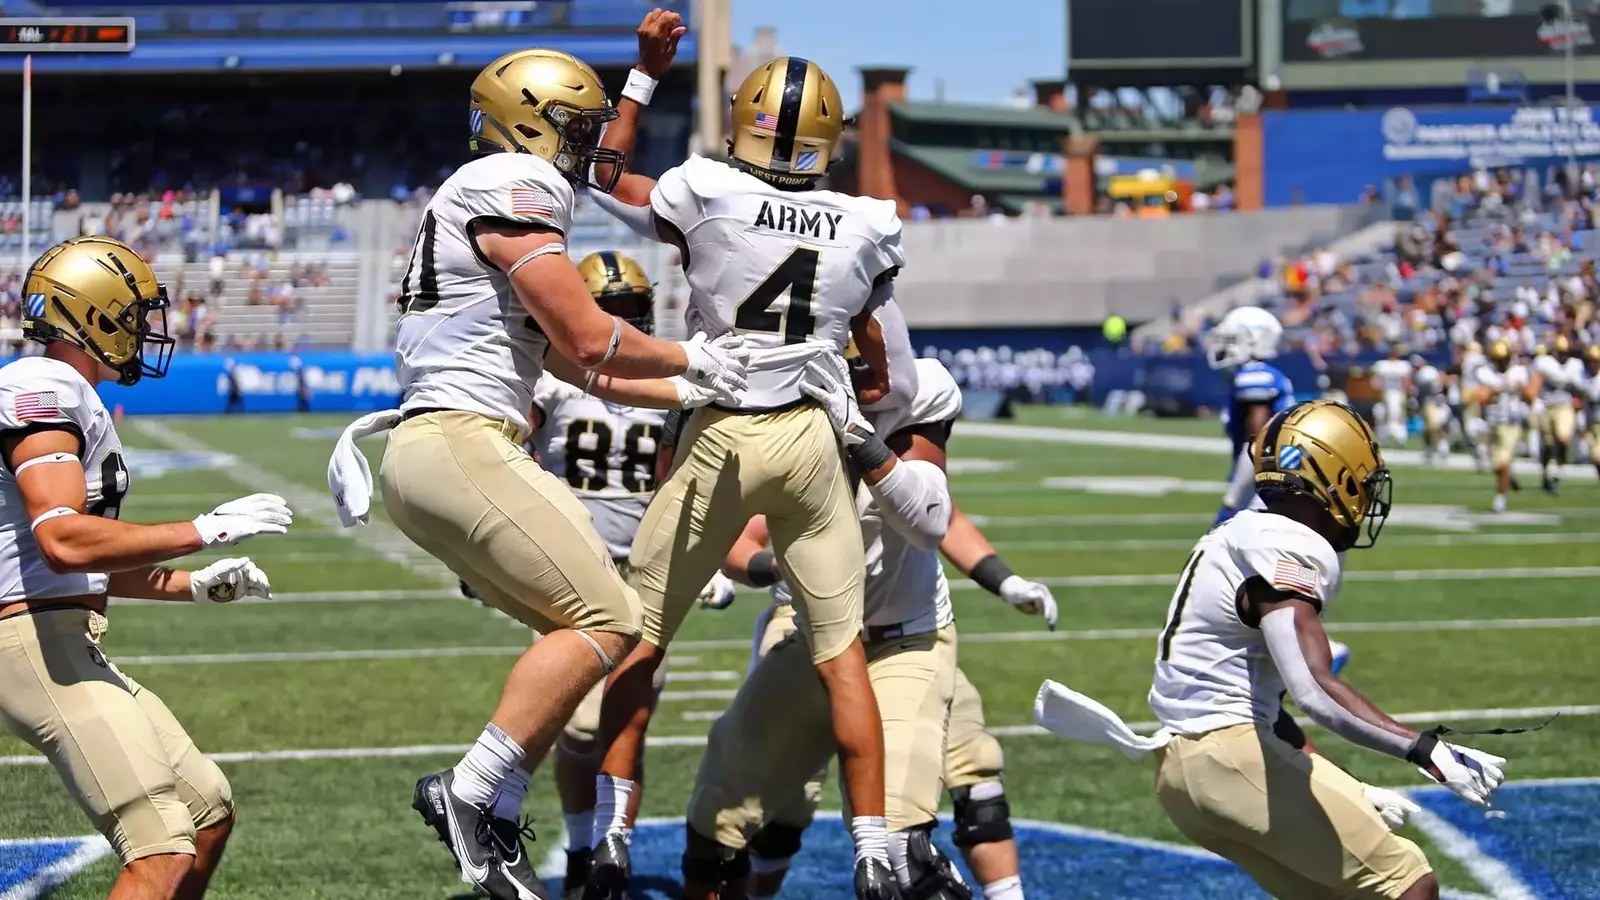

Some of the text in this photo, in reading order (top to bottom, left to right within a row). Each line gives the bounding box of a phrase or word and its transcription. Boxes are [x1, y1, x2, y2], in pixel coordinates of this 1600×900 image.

[749, 167, 809, 185] WEST POINT
[754, 200, 843, 240] ARMY
[733, 245, 823, 345] 4
[565, 418, 662, 493] 88
